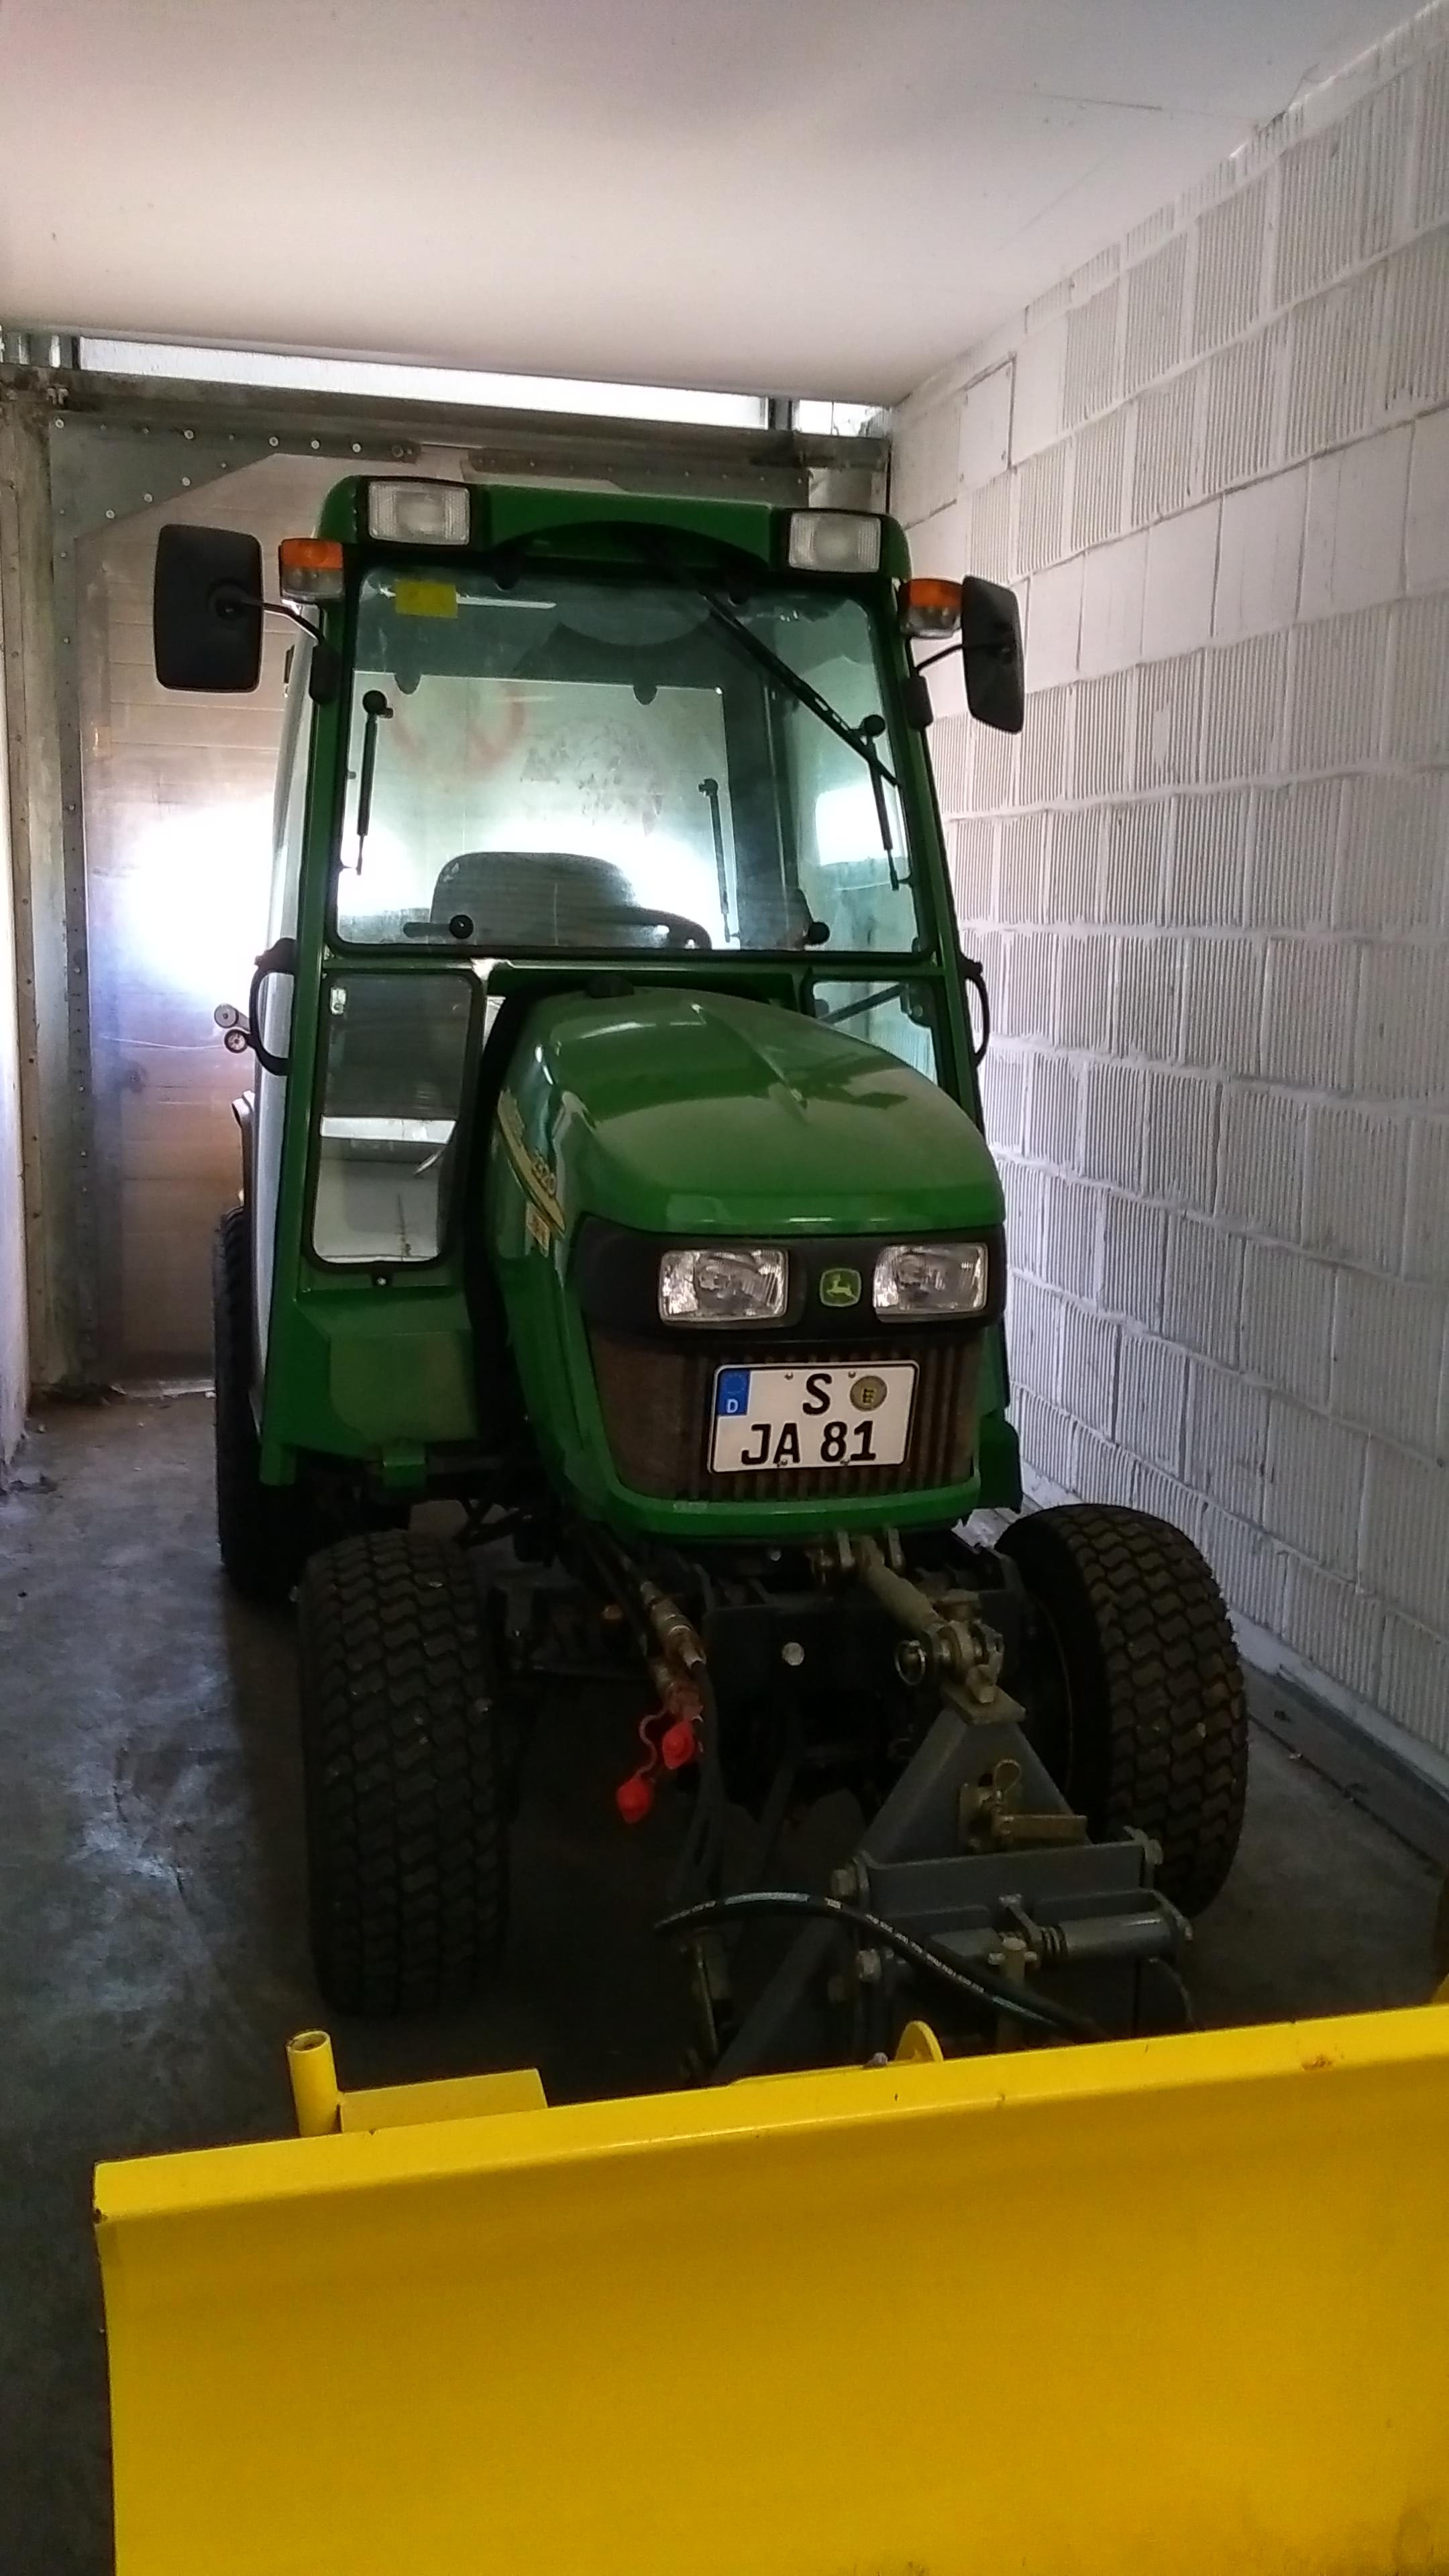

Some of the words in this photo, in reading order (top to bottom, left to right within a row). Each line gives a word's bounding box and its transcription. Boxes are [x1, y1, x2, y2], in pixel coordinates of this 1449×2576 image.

[727, 1399, 739, 1413] D
[802, 1373, 833, 1415] S
[741, 1423, 800, 1465] JA
[820, 1420, 877, 1462] 81
